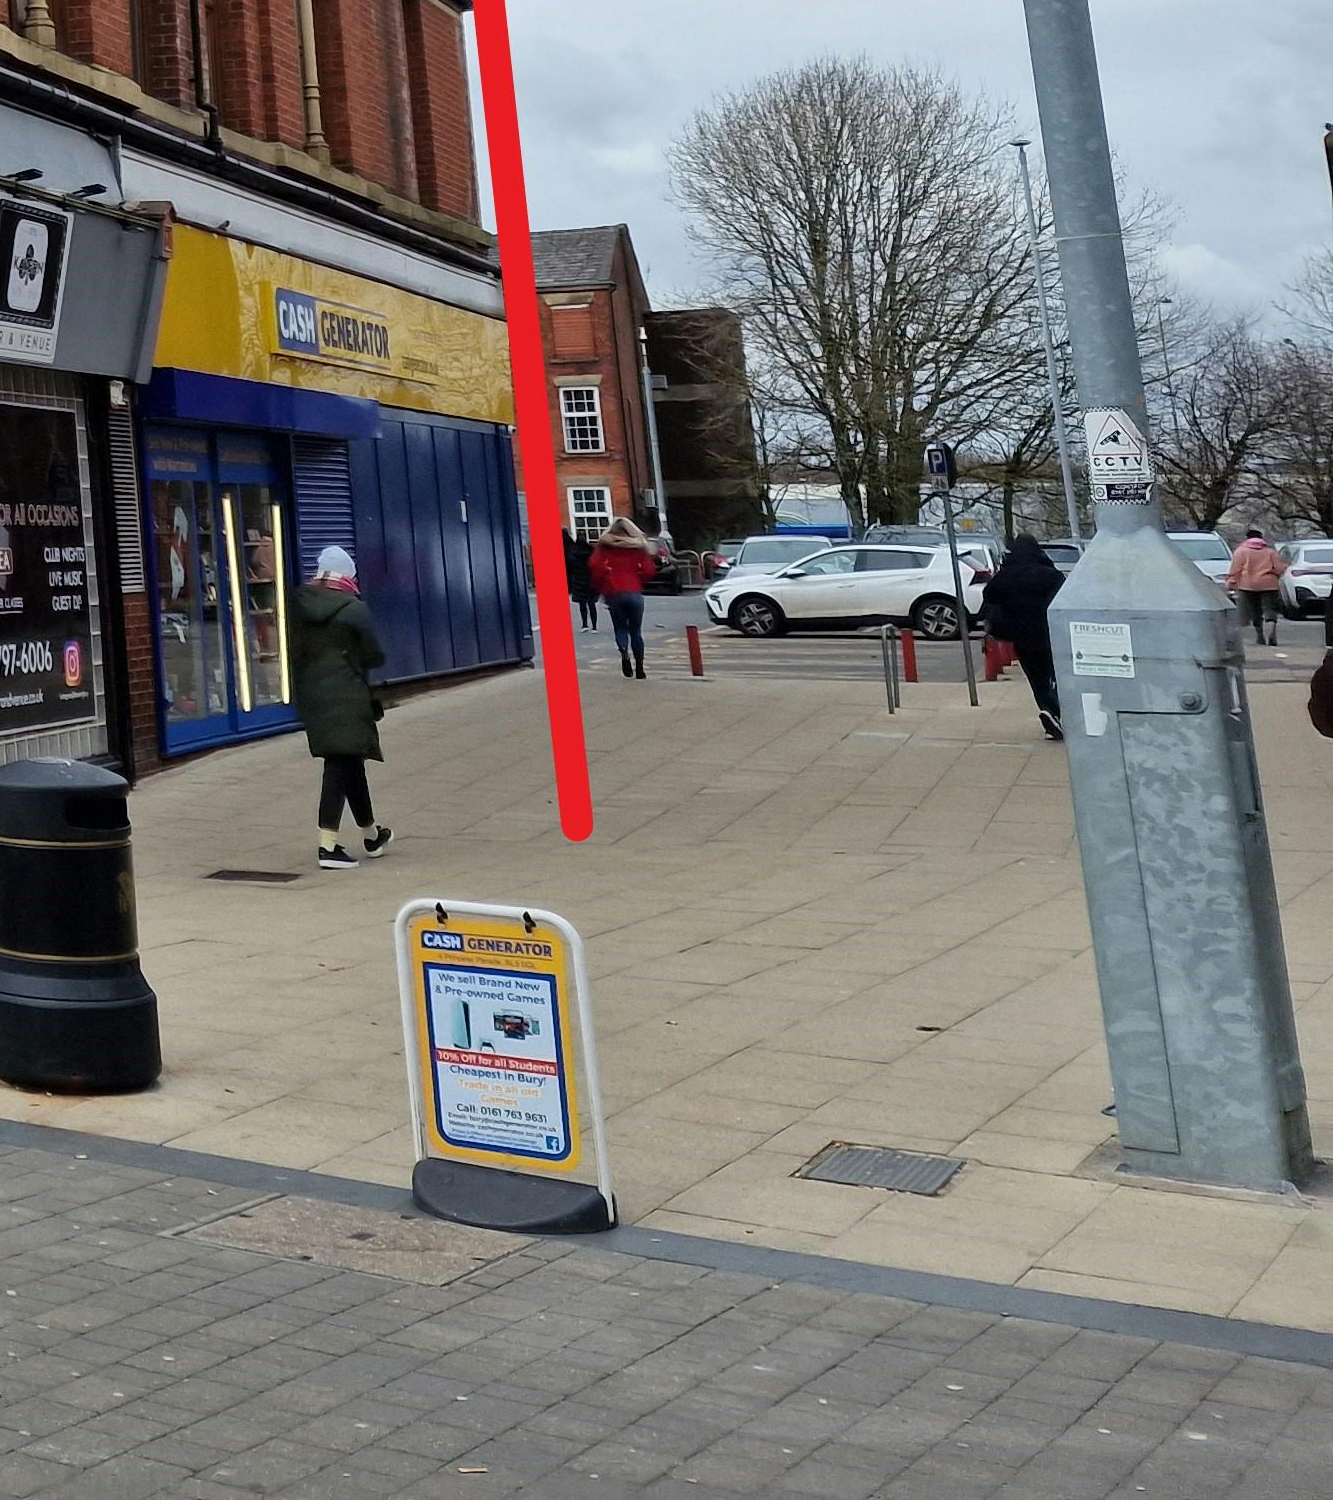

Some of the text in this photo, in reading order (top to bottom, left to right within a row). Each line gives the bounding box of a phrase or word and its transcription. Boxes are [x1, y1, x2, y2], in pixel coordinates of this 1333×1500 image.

[278, 299, 391, 360] CASH GENERATOR
[20, 333, 52, 351] VENUE
[932, 452, 943, 473] P
[1093, 456, 1143, 467] CCTV
[27, 503, 79, 527] OCCASIONS
[61, 546, 85, 563] NIGHTS
[48, 570, 83, 587] LIVE MUSIC
[51, 595, 72, 611] GUEST
[1074, 624, 1125, 633] FRESHCUT
[423, 932, 553, 958] CASH GENERATOR
[438, 972, 541, 992] We sell Brand New
[435, 985, 546, 1005] & Pre-owned Games
[438, 1050, 556, 1074] 10% Off for all Students
[449, 1064, 502, 1080] Cheapest
[504, 1071, 515, 1081] in
[480, 1106, 502, 1117] 0161
[504, 1109, 523, 1121] 763
[524, 1112, 548, 1124] 9631
